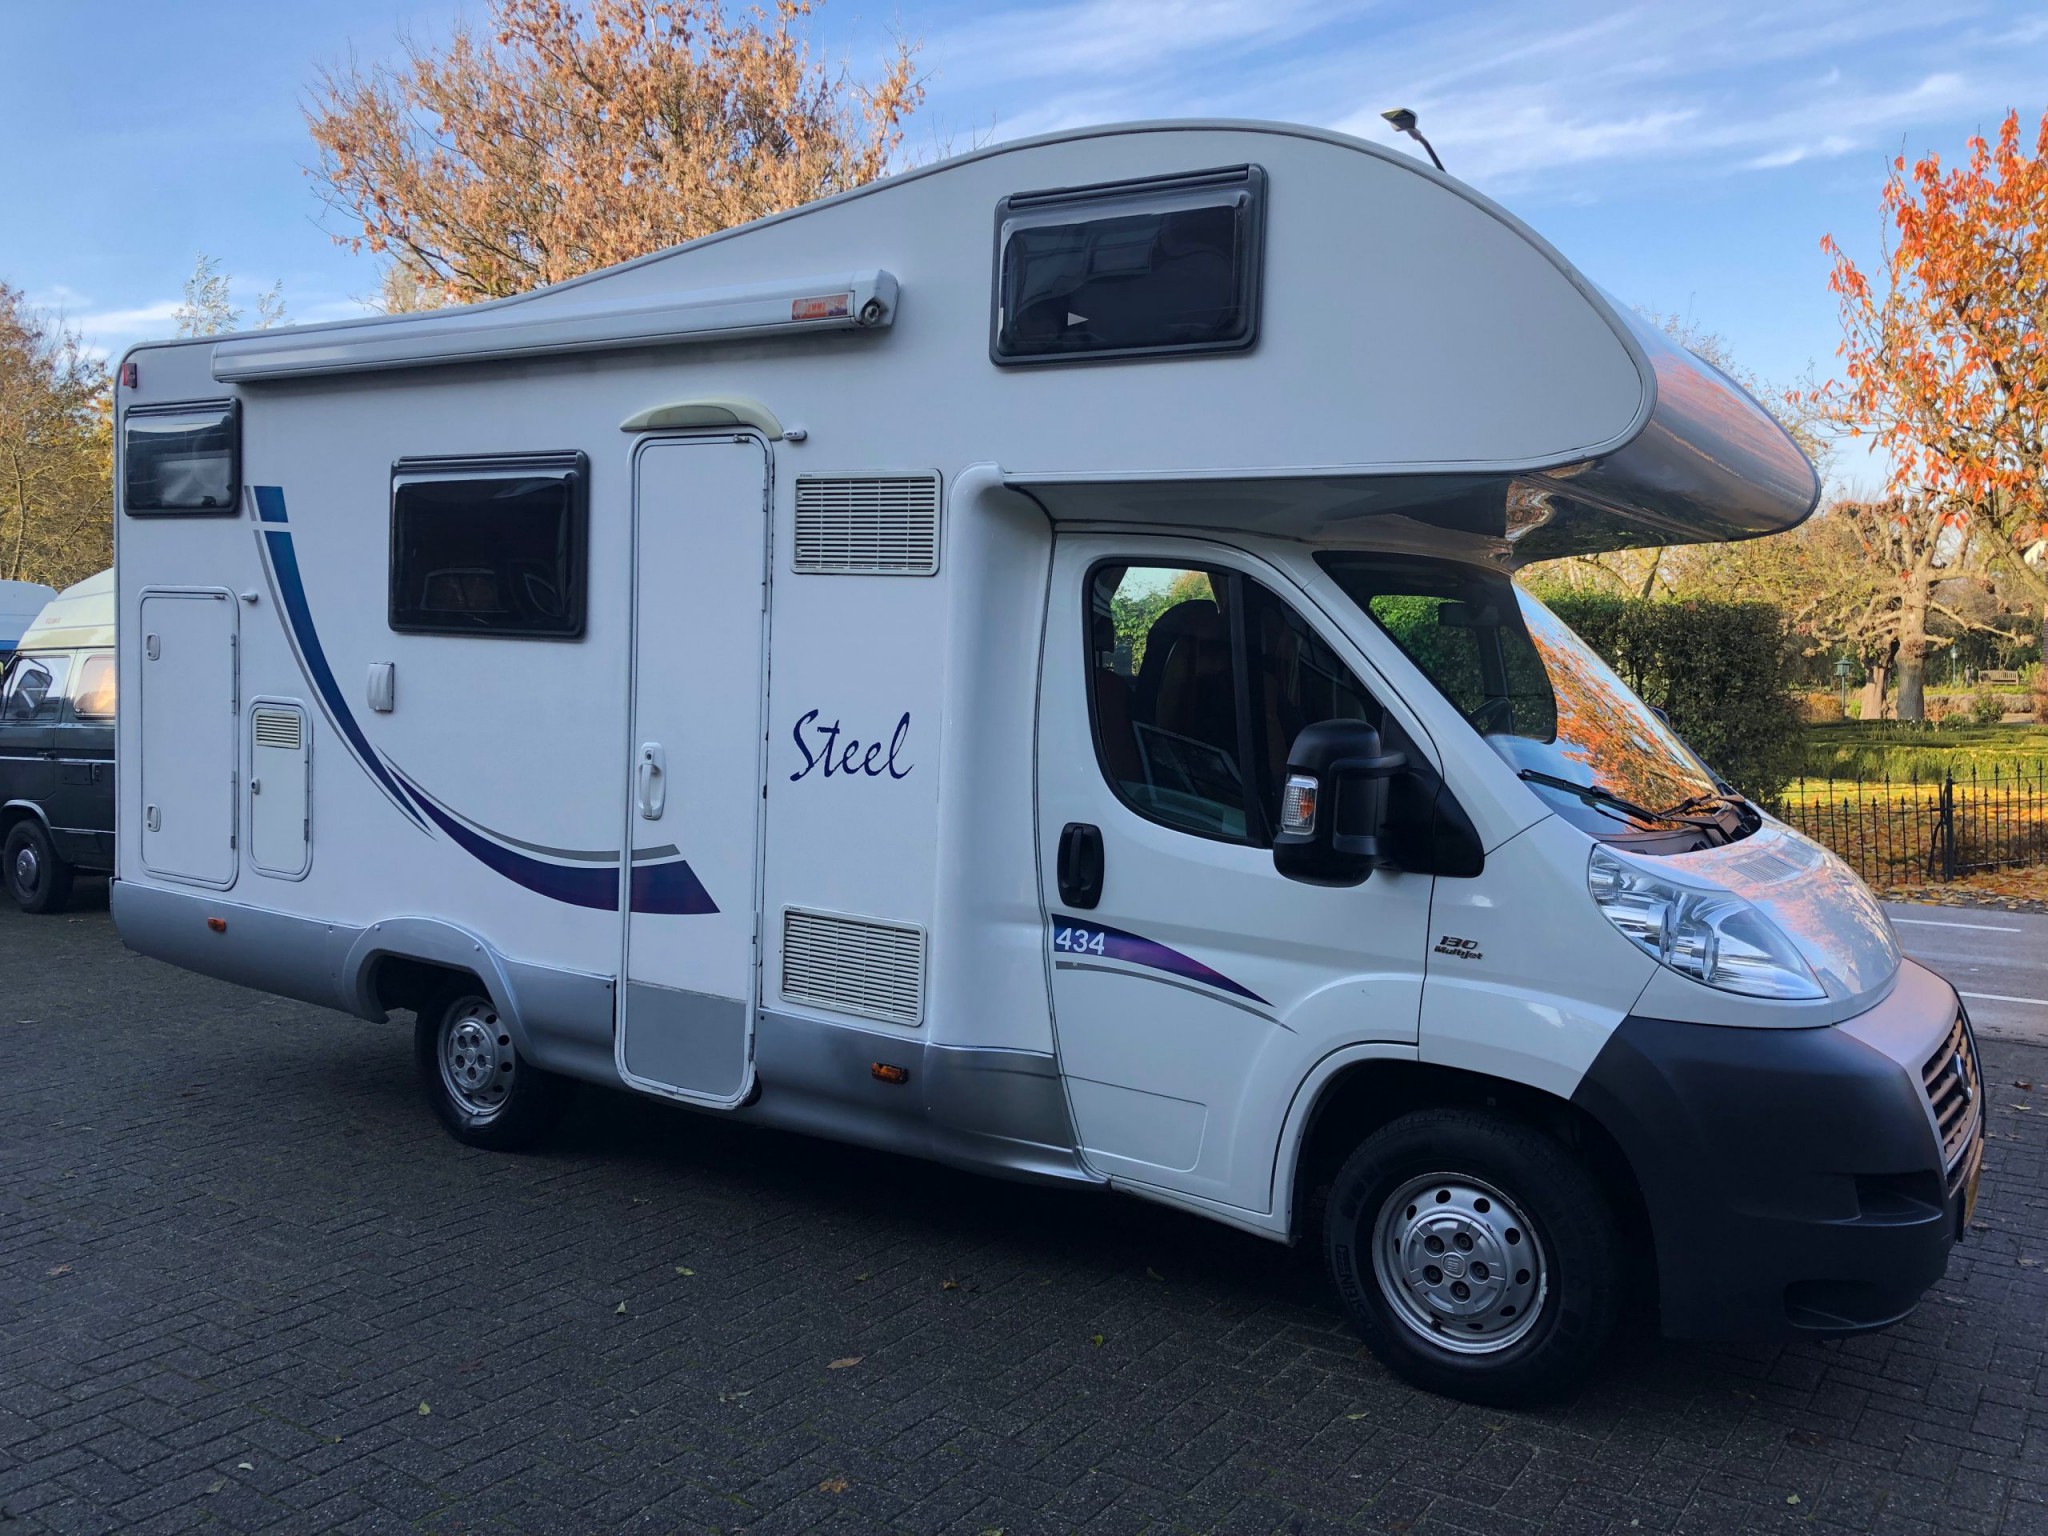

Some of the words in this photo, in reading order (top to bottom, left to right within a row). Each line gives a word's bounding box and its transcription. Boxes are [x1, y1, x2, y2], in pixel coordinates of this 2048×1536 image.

[790, 708, 915, 782] Steel
[1055, 927, 1105, 955] 434
[1440, 935, 1478, 950] 130
